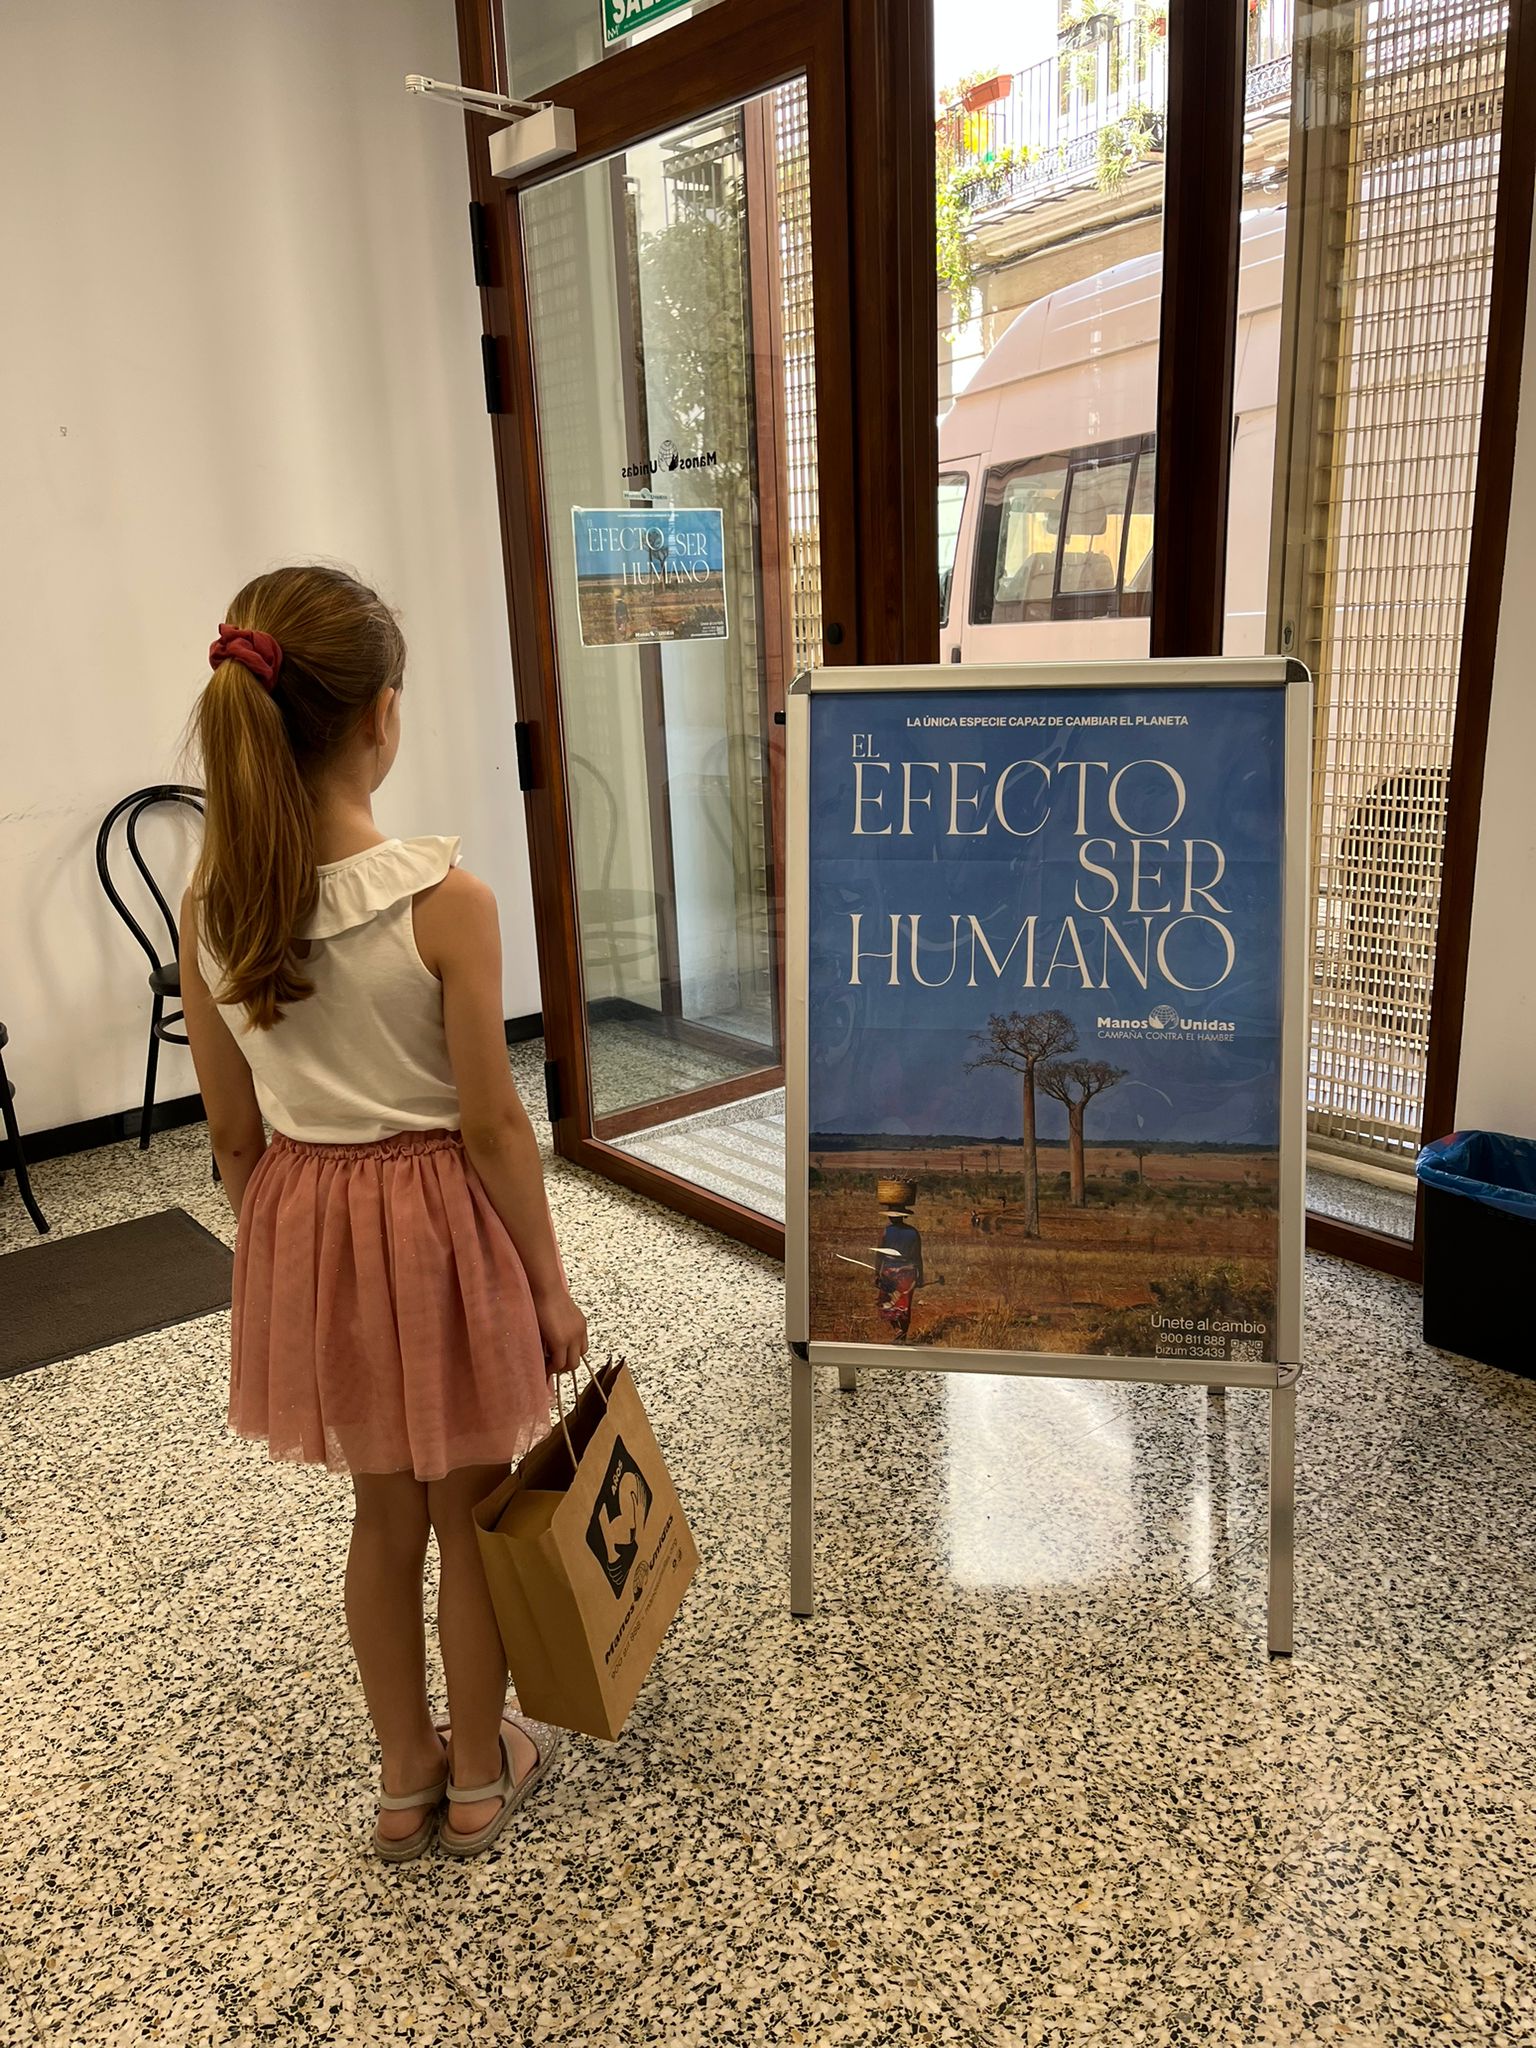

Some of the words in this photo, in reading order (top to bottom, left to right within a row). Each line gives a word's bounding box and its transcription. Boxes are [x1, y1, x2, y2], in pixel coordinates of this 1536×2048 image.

[588, 527, 664, 551] EFECTO
[676, 532, 708, 556] SER
[623, 560, 710, 585] HUMANO
[906, 717, 921, 727] LA
[923, 715, 958, 727] ÚNICA
[960, 717, 1007, 727] ESPECIE
[1008, 716, 1046, 727] CAPAZ
[1048, 716, 1063, 726] DE
[1065, 716, 1118, 726] CAMBIAR
[1120, 716, 1133, 726] EL
[1135, 715, 1189, 726] PLANETA
[851, 734, 880, 758] EL
[850, 759, 1187, 837] EFECTO
[1074, 838, 1233, 914] SER
[848, 913, 1237, 992] HUMANO
[1097, 1017, 1149, 1029] Manos
[1180, 1019, 1236, 1031] Unidas
[1097, 1030, 1143, 1040] CAMPAÑA
[1145, 1031, 1183, 1041] CONTRA
[1186, 1033, 1195, 1041] EL
[1197, 1033, 1235, 1042] HAMBRE
[1151, 1311, 1194, 1330] Únete
[1197, 1317, 1209, 1331] al
[1212, 1320, 1267, 1334] cambio
[1155, 1344, 1188, 1355] bizum
[1189, 1346, 1225, 1358] 33439
[1160, 1332, 1183, 1343] 900
[1185, 1334, 1201, 1345] 811
[1203, 1335, 1226, 1346] 888
[605, 1602, 635, 1665] Manos
[649, 1514, 674, 1570] Unidas
